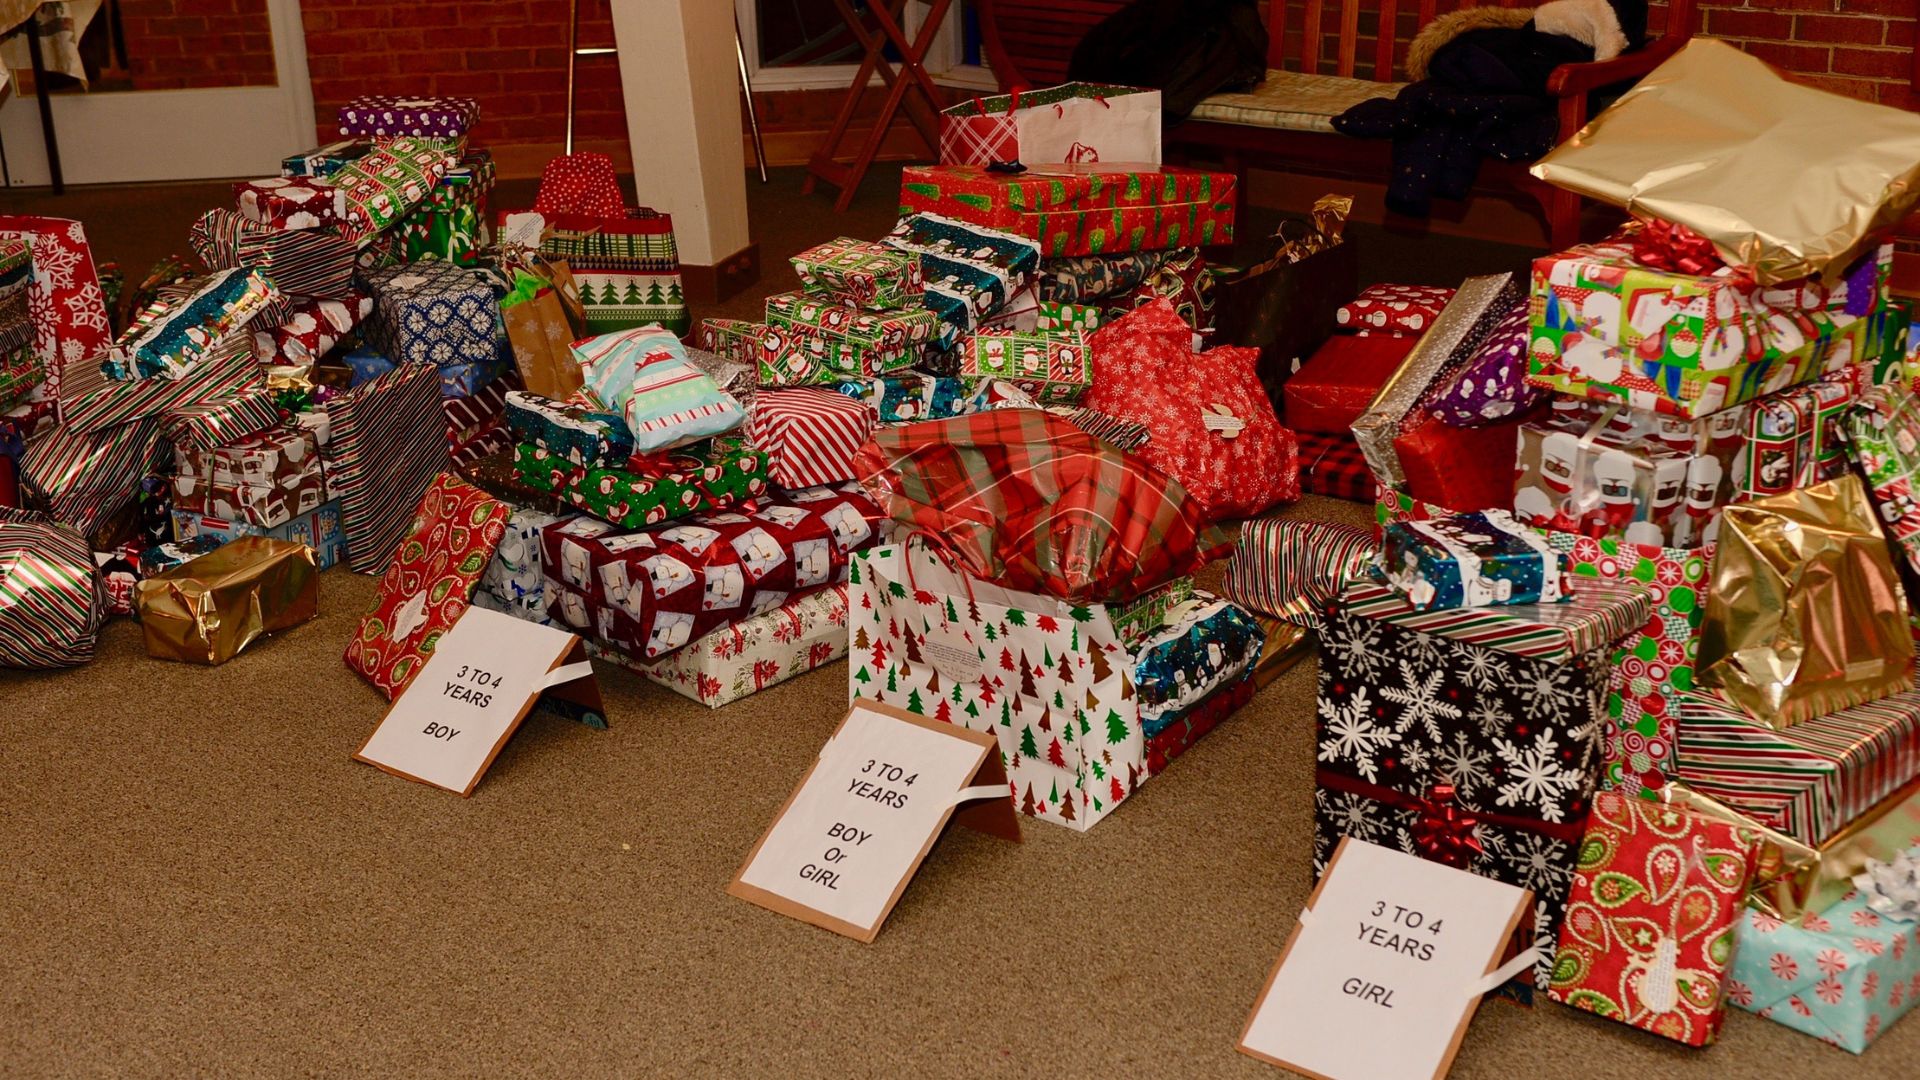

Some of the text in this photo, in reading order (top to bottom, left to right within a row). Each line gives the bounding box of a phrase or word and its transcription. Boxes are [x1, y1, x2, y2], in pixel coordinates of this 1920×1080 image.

[456, 665, 503, 689] 3 TO 4
[443, 681, 493, 709] YEARS
[422, 721, 461, 742] BOY
[861, 759, 919, 787] 3 TO 4
[847, 778, 909, 809] YEARS
[827, 822, 873, 846] BOY
[823, 847, 848, 864] Or
[799, 863, 841, 890] GIRL
[1371, 900, 1443, 935] 3 TO 4
[1358, 922, 1435, 961] YEARS
[1342, 977, 1394, 1008] GIRL
